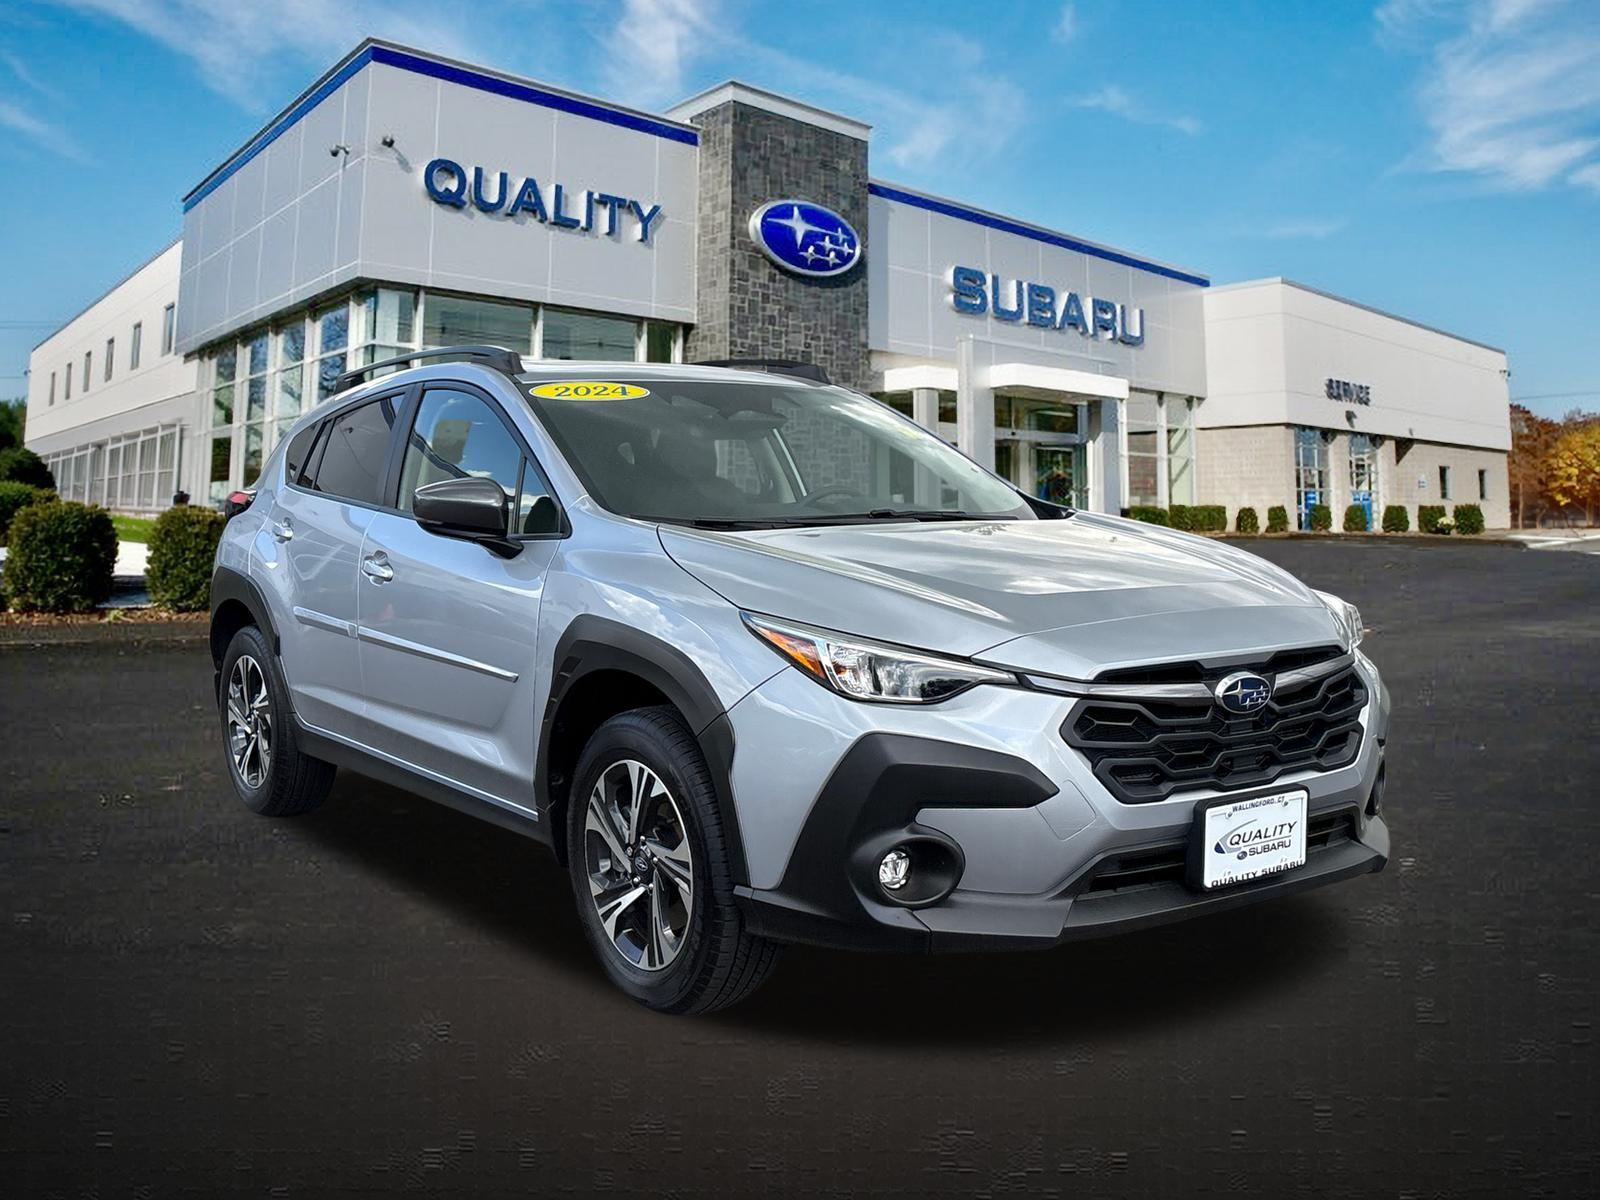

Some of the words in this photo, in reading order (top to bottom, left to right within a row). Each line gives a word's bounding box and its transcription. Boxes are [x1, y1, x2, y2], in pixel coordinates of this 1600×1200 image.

[424, 158, 661, 243] QUALITY
[952, 266, 1145, 346] SUBARU
[554, 385, 630, 397] 2024
[1325, 378, 1371, 407] SERVICE
[1229, 821, 1297, 846] QUALITY
[1248, 839, 1291, 856] SUBARU
[1211, 871, 1258, 888] QUALITY
[1261, 859, 1303, 876] SUBARU
